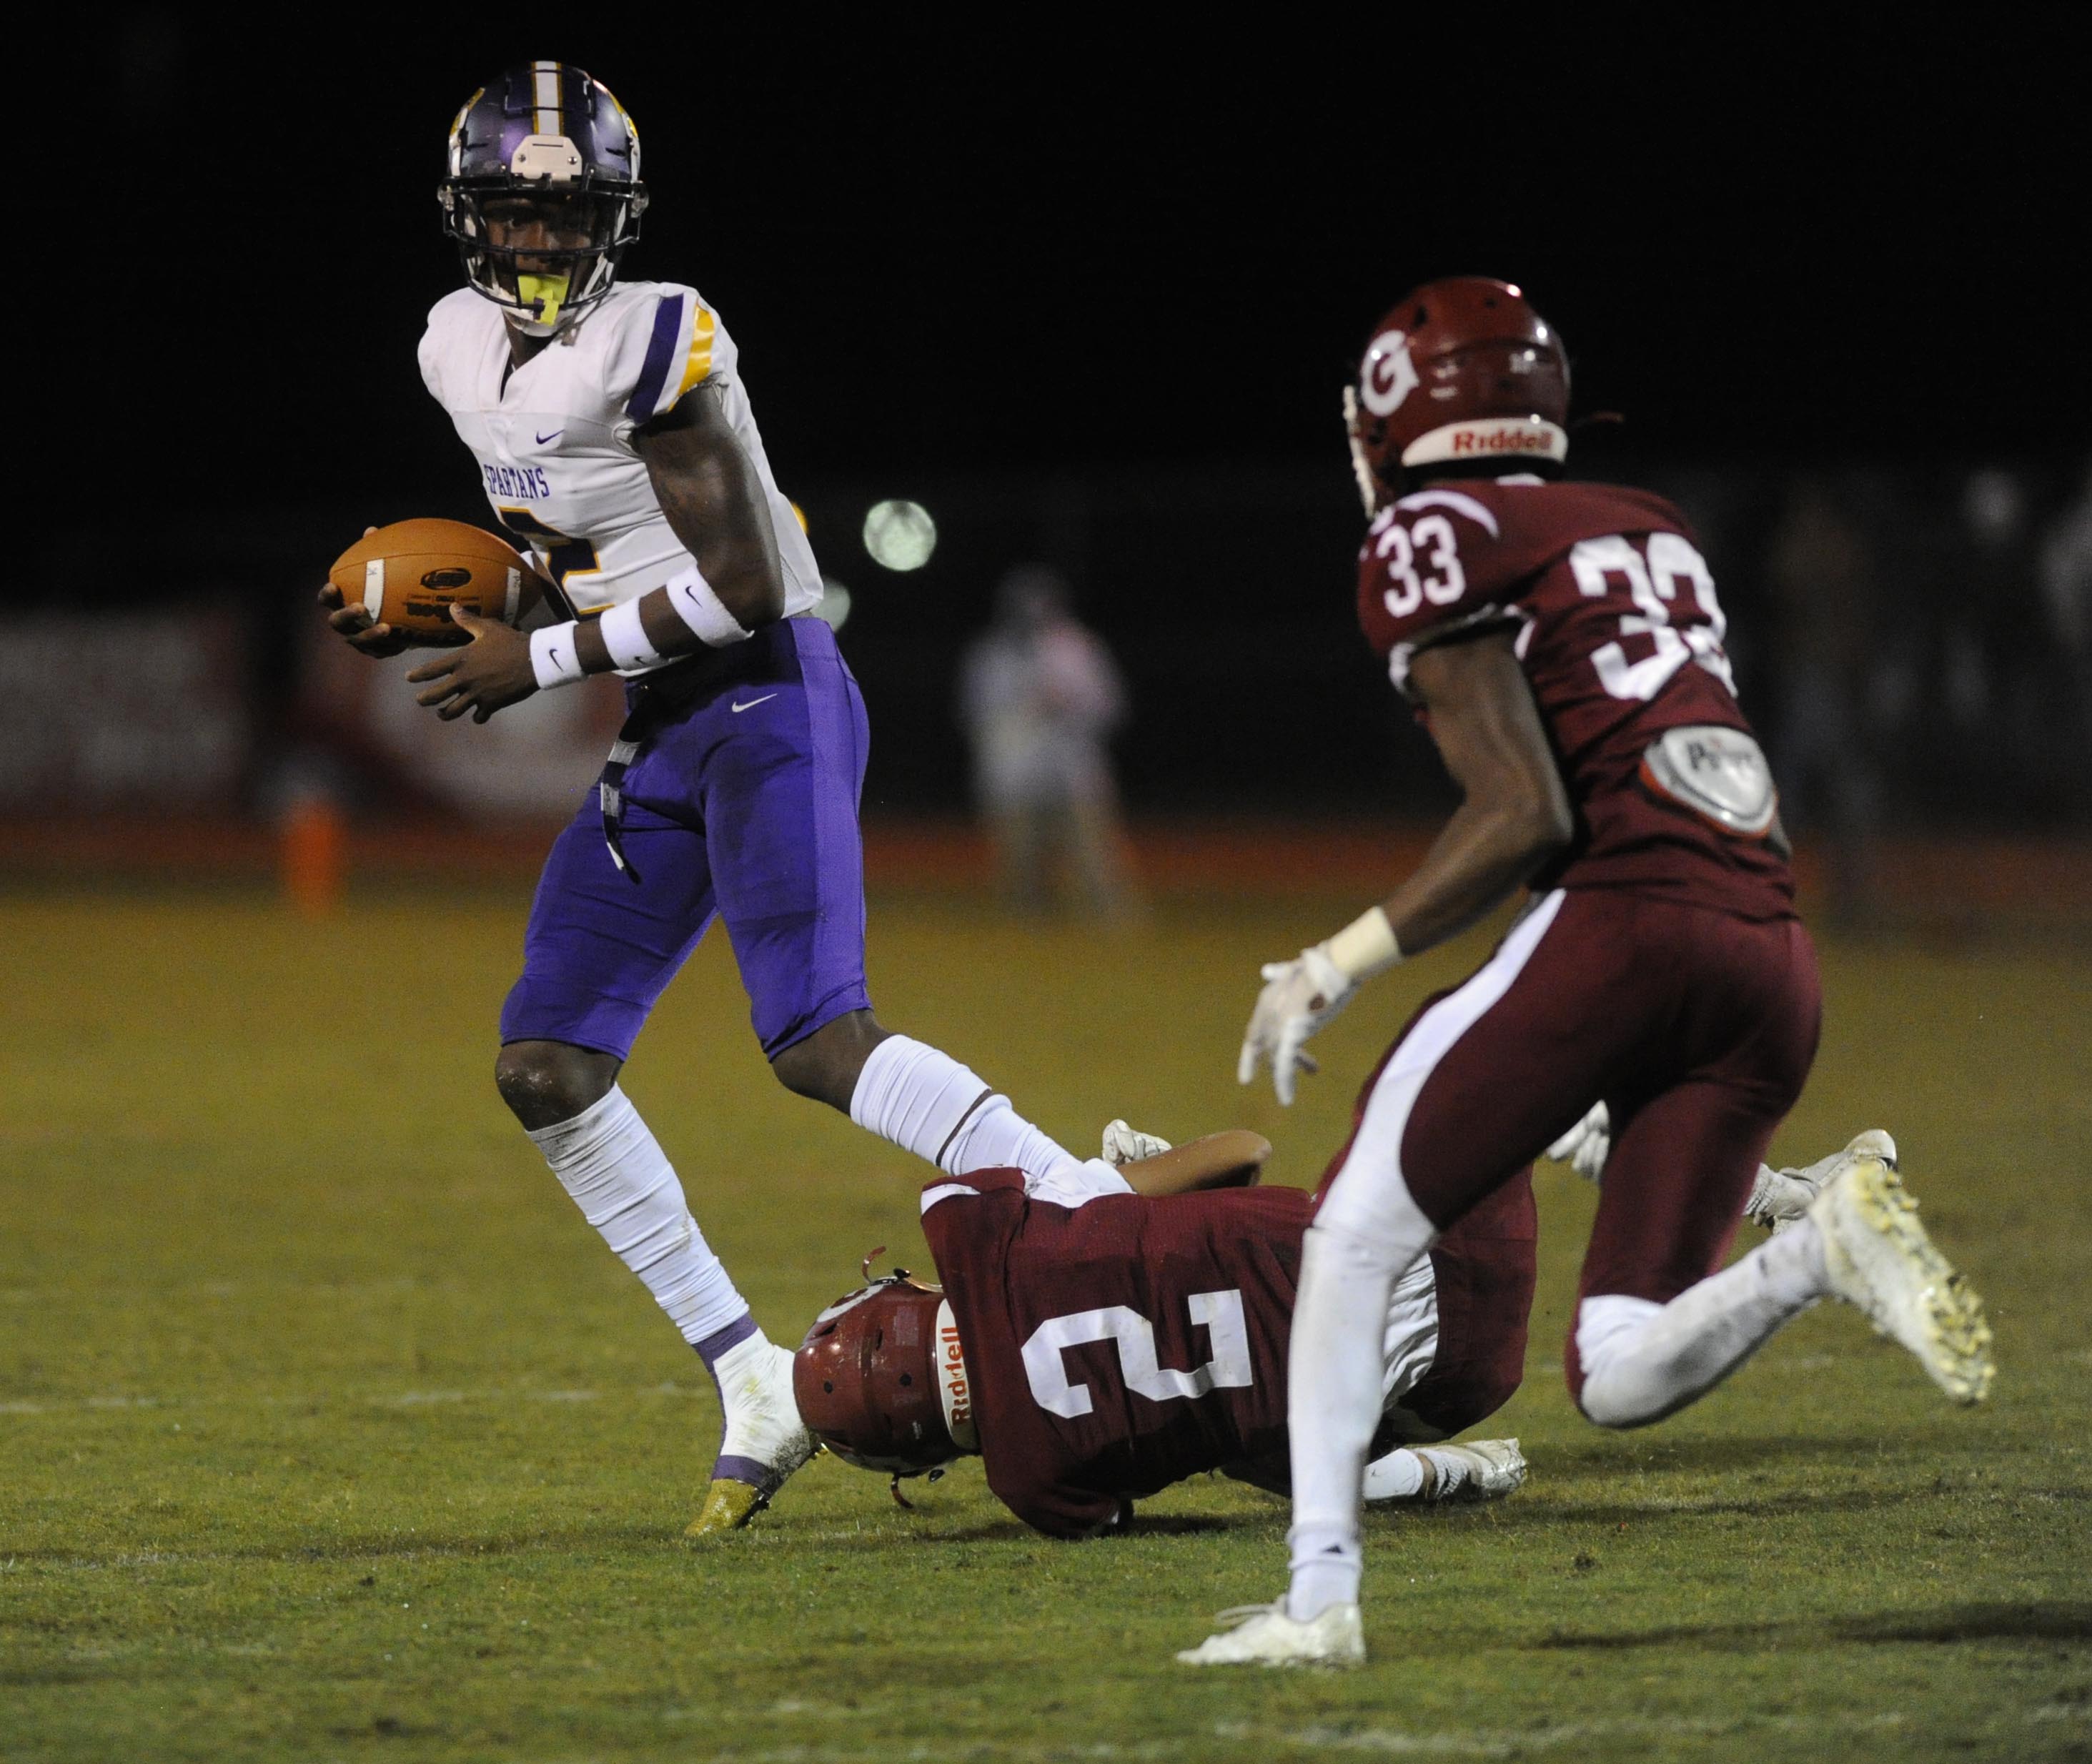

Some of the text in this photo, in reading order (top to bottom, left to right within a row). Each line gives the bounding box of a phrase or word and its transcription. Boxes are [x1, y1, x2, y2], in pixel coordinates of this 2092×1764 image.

[1360, 329, 1420, 417] G
[483, 464, 550, 499] SPARTANS
[1453, 428, 1553, 452] Riddell
[1377, 515, 1467, 618] 33
[1569, 531, 1738, 700] 33
[941, 1326, 971, 1426] Riddell
[1021, 1288, 1254, 1419] 2
